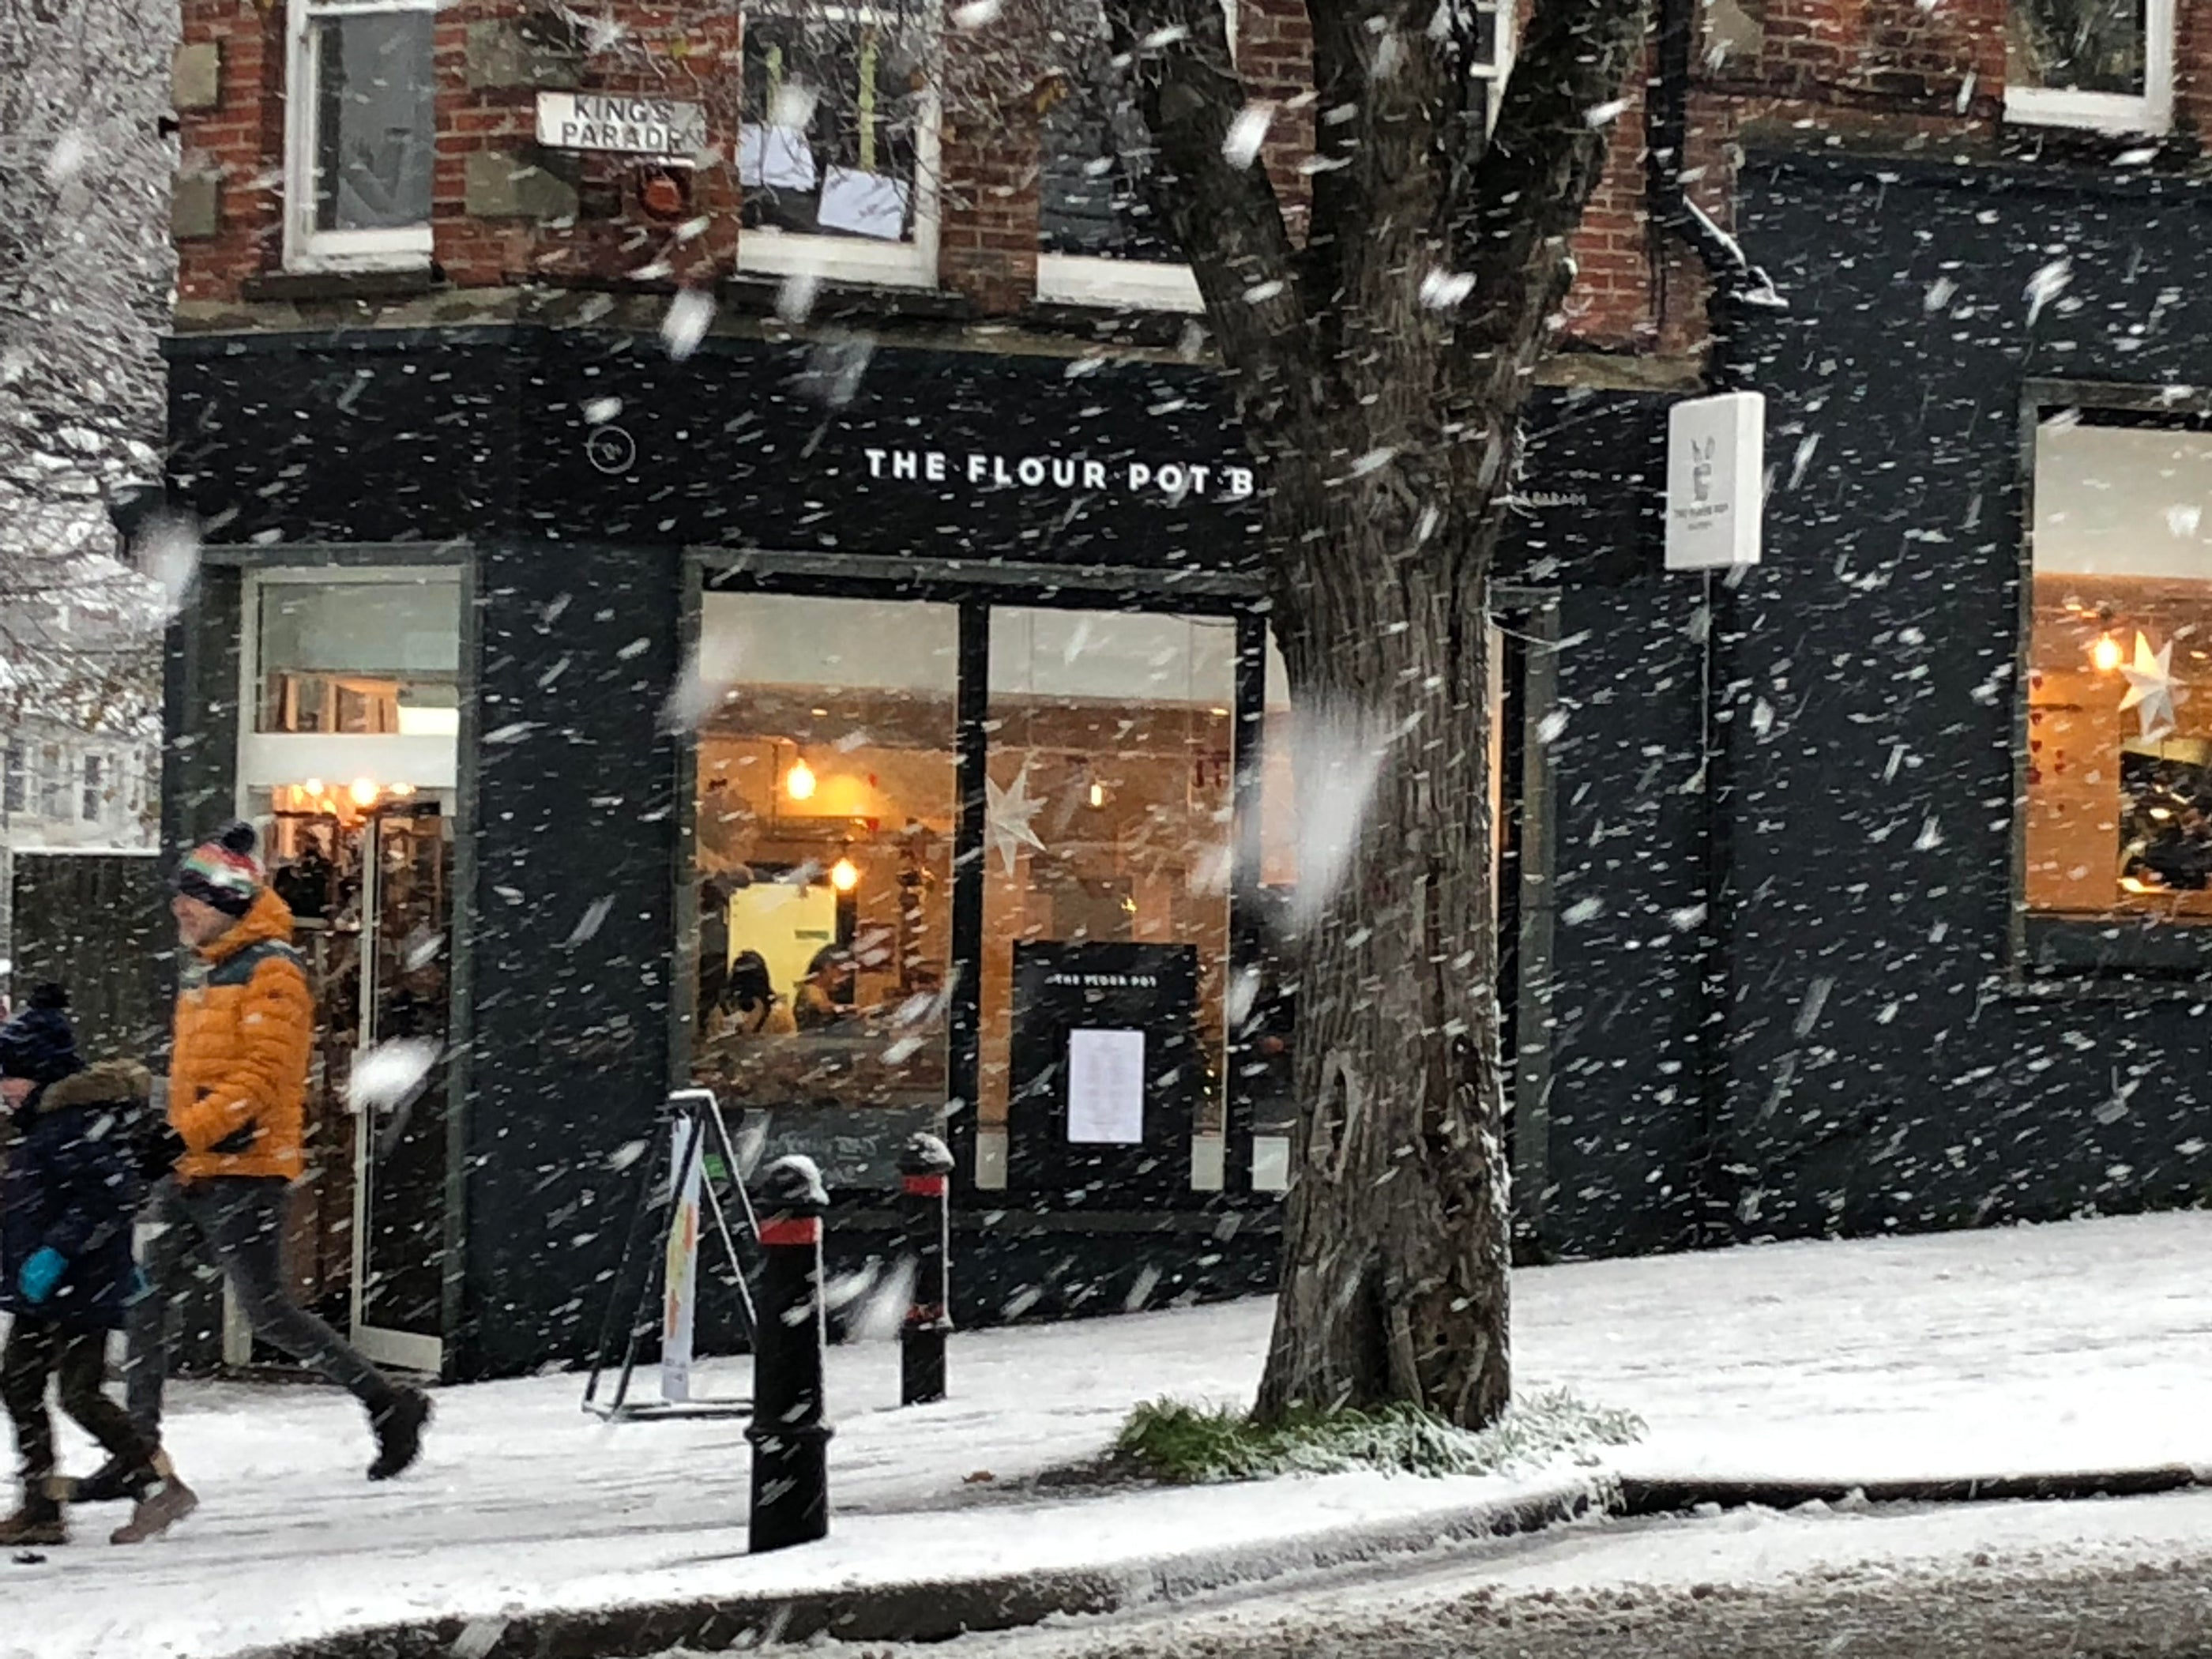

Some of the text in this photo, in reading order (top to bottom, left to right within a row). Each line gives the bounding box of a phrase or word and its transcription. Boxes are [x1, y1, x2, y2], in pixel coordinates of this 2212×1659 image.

[864, 448, 946, 482] THE
[967, 453, 1108, 491] FLOUR
[1128, 461, 1211, 495] POT
